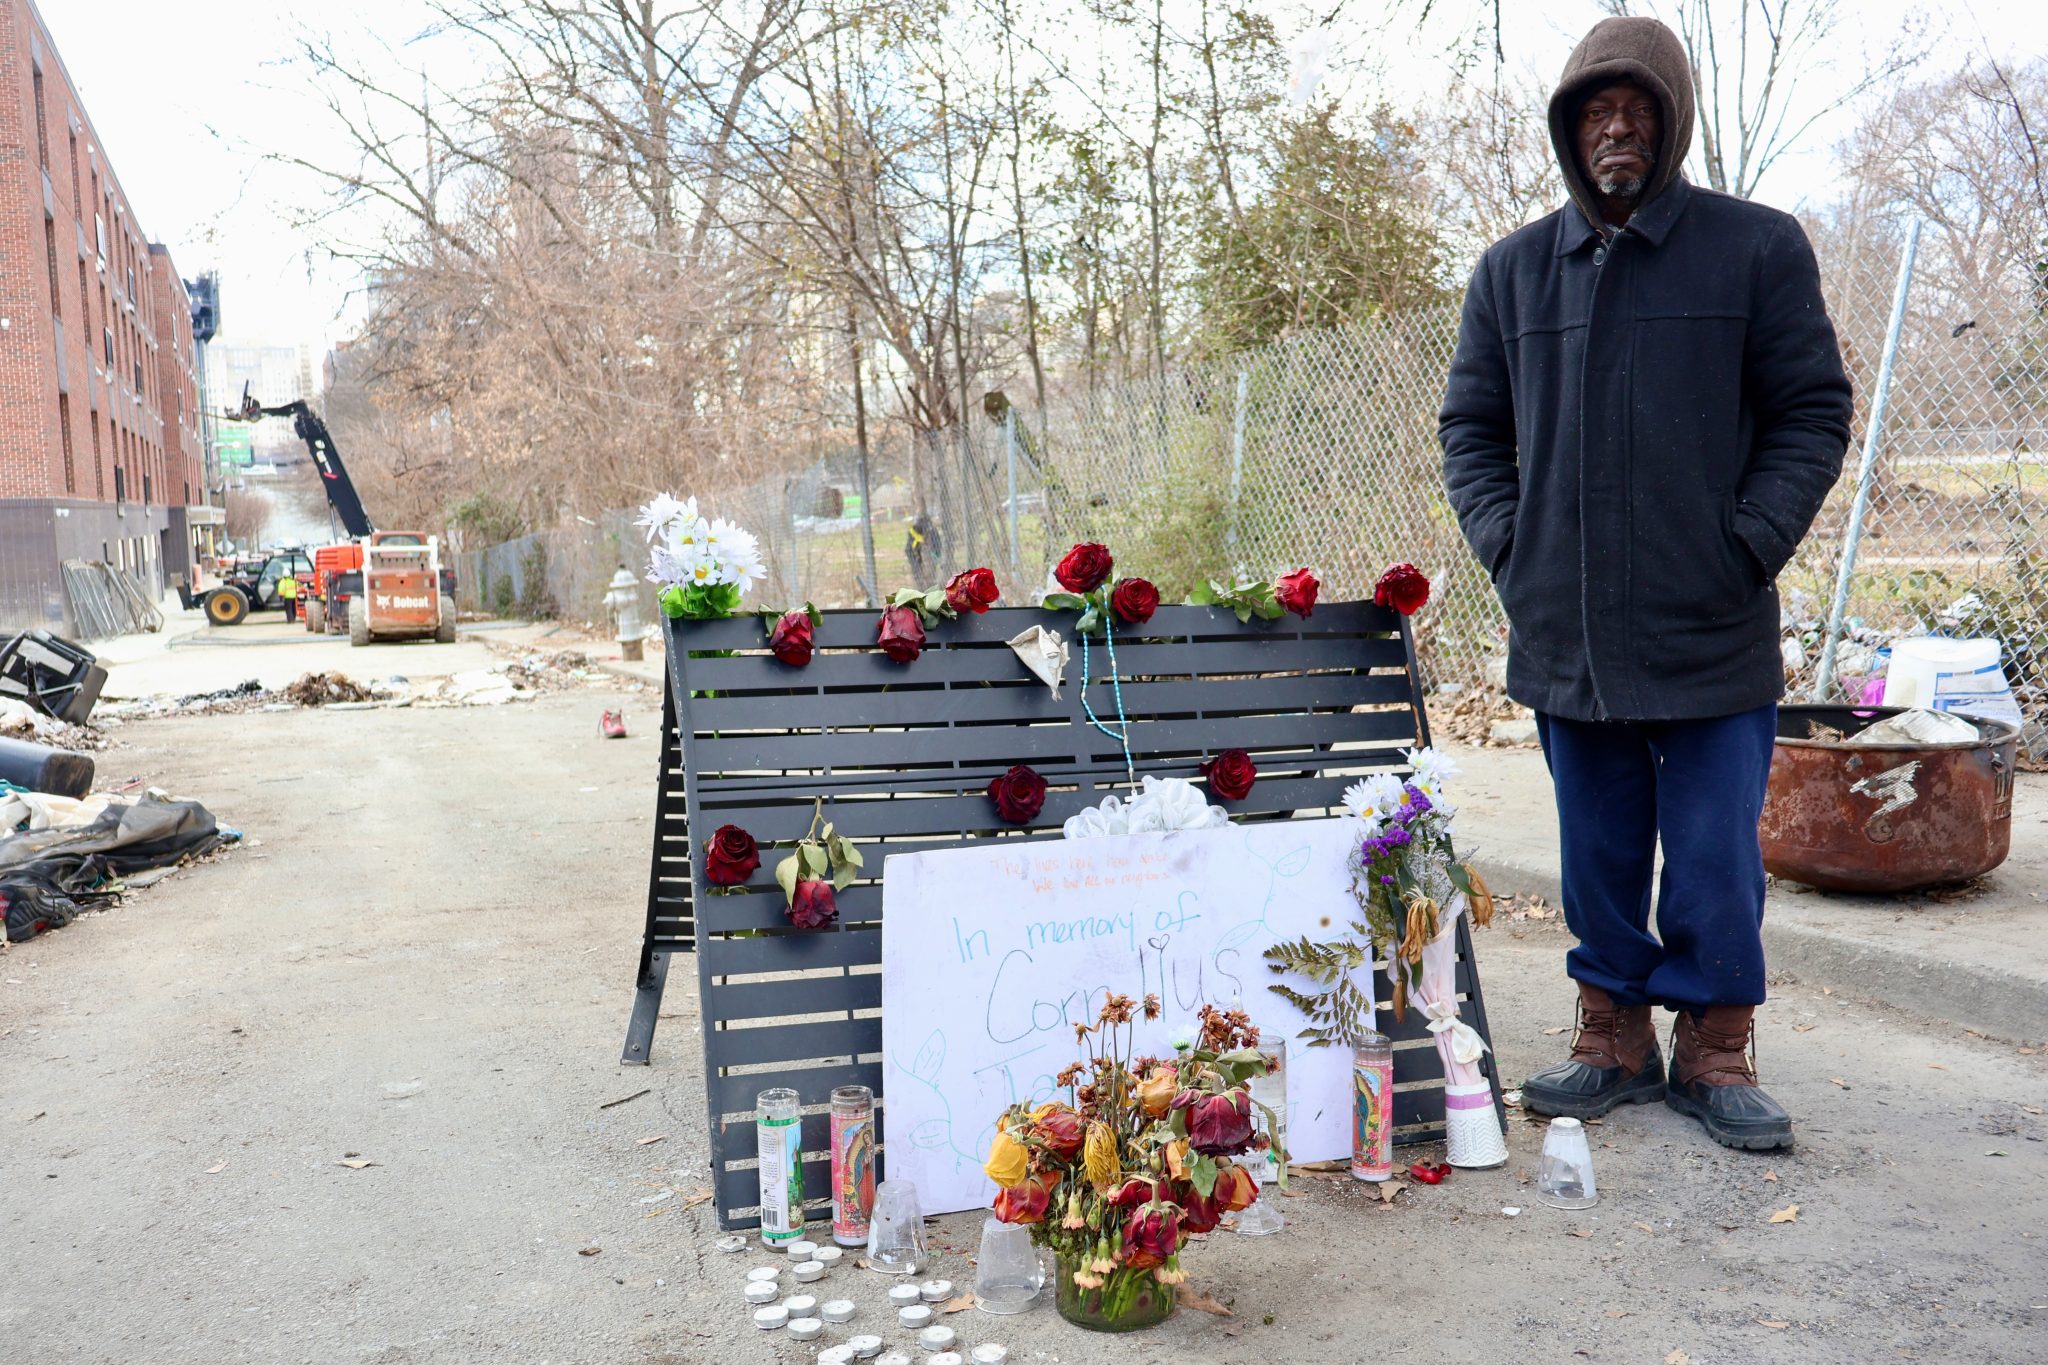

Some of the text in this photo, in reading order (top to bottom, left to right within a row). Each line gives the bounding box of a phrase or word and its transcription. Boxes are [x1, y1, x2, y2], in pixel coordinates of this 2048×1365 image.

[393, 595, 428, 608] Bobcat
[953, 890, 1201, 963] In memory of
[986, 934, 1243, 1043] Cornlius
